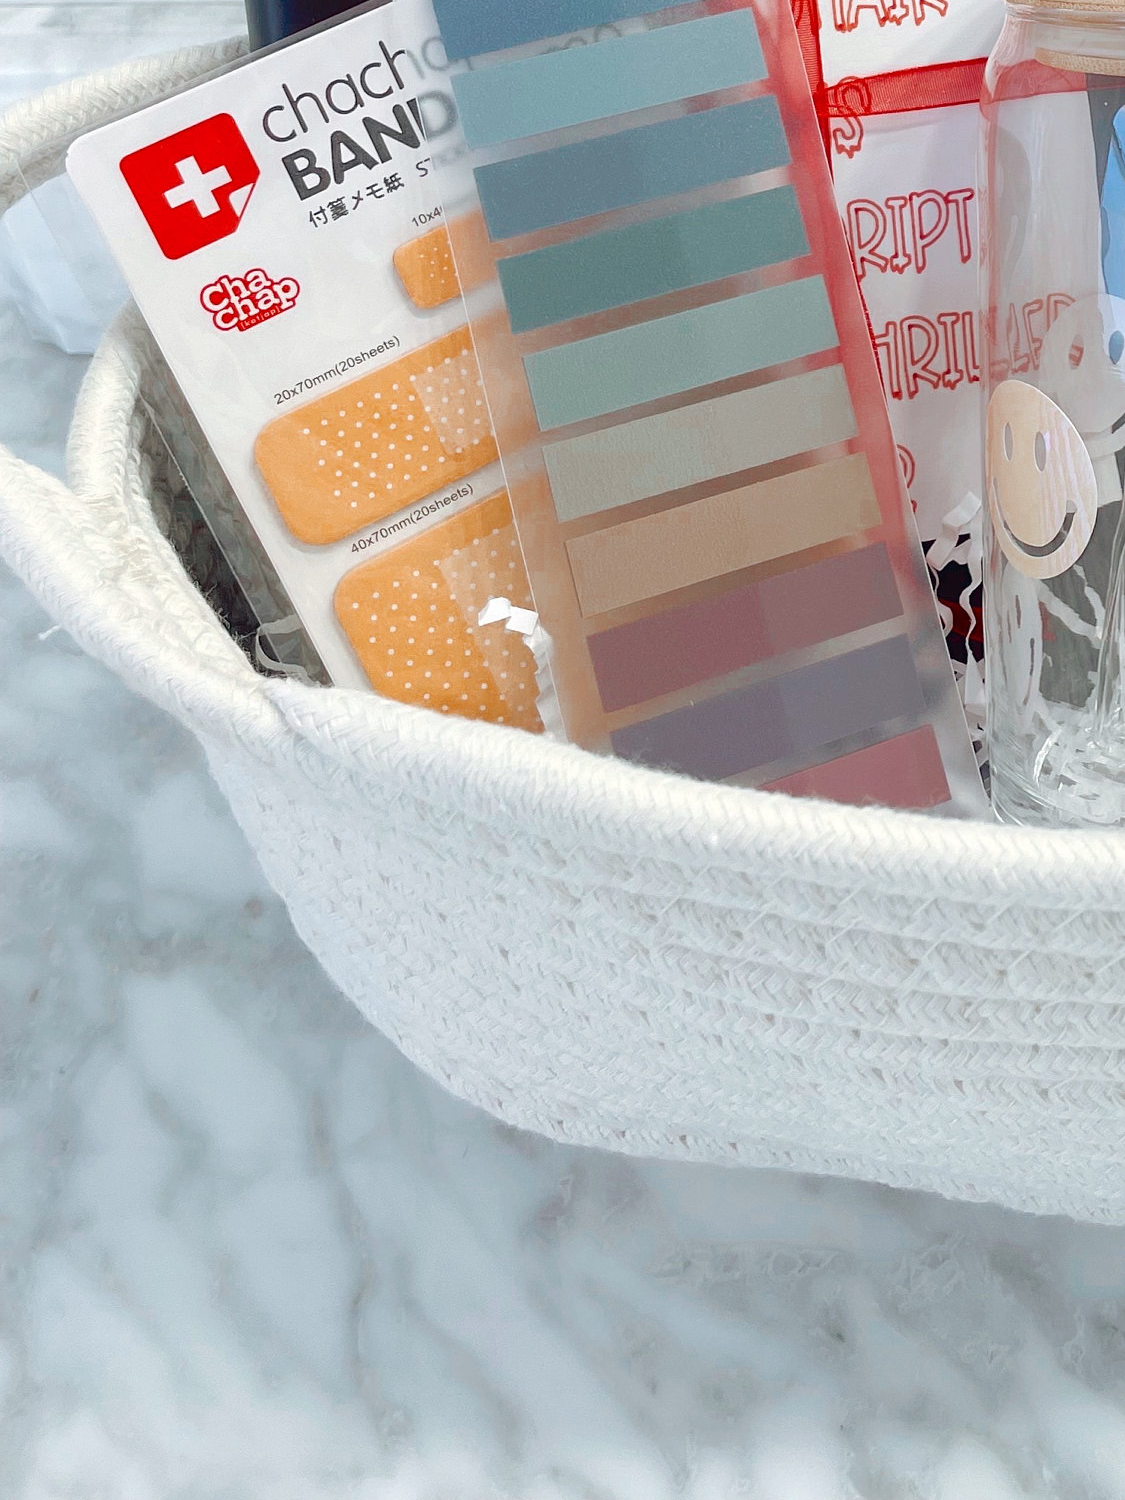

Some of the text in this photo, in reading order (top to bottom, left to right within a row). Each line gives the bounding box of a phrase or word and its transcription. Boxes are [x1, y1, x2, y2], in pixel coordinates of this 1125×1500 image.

[845, 188, 975, 282] RIPT
[202, 268, 271, 312] Cha
[215, 279, 298, 330] chap
[273, 334, 401, 405] 20x70mm(20sheets)
[350, 482, 475, 555] 40x70mm(20sheets)
